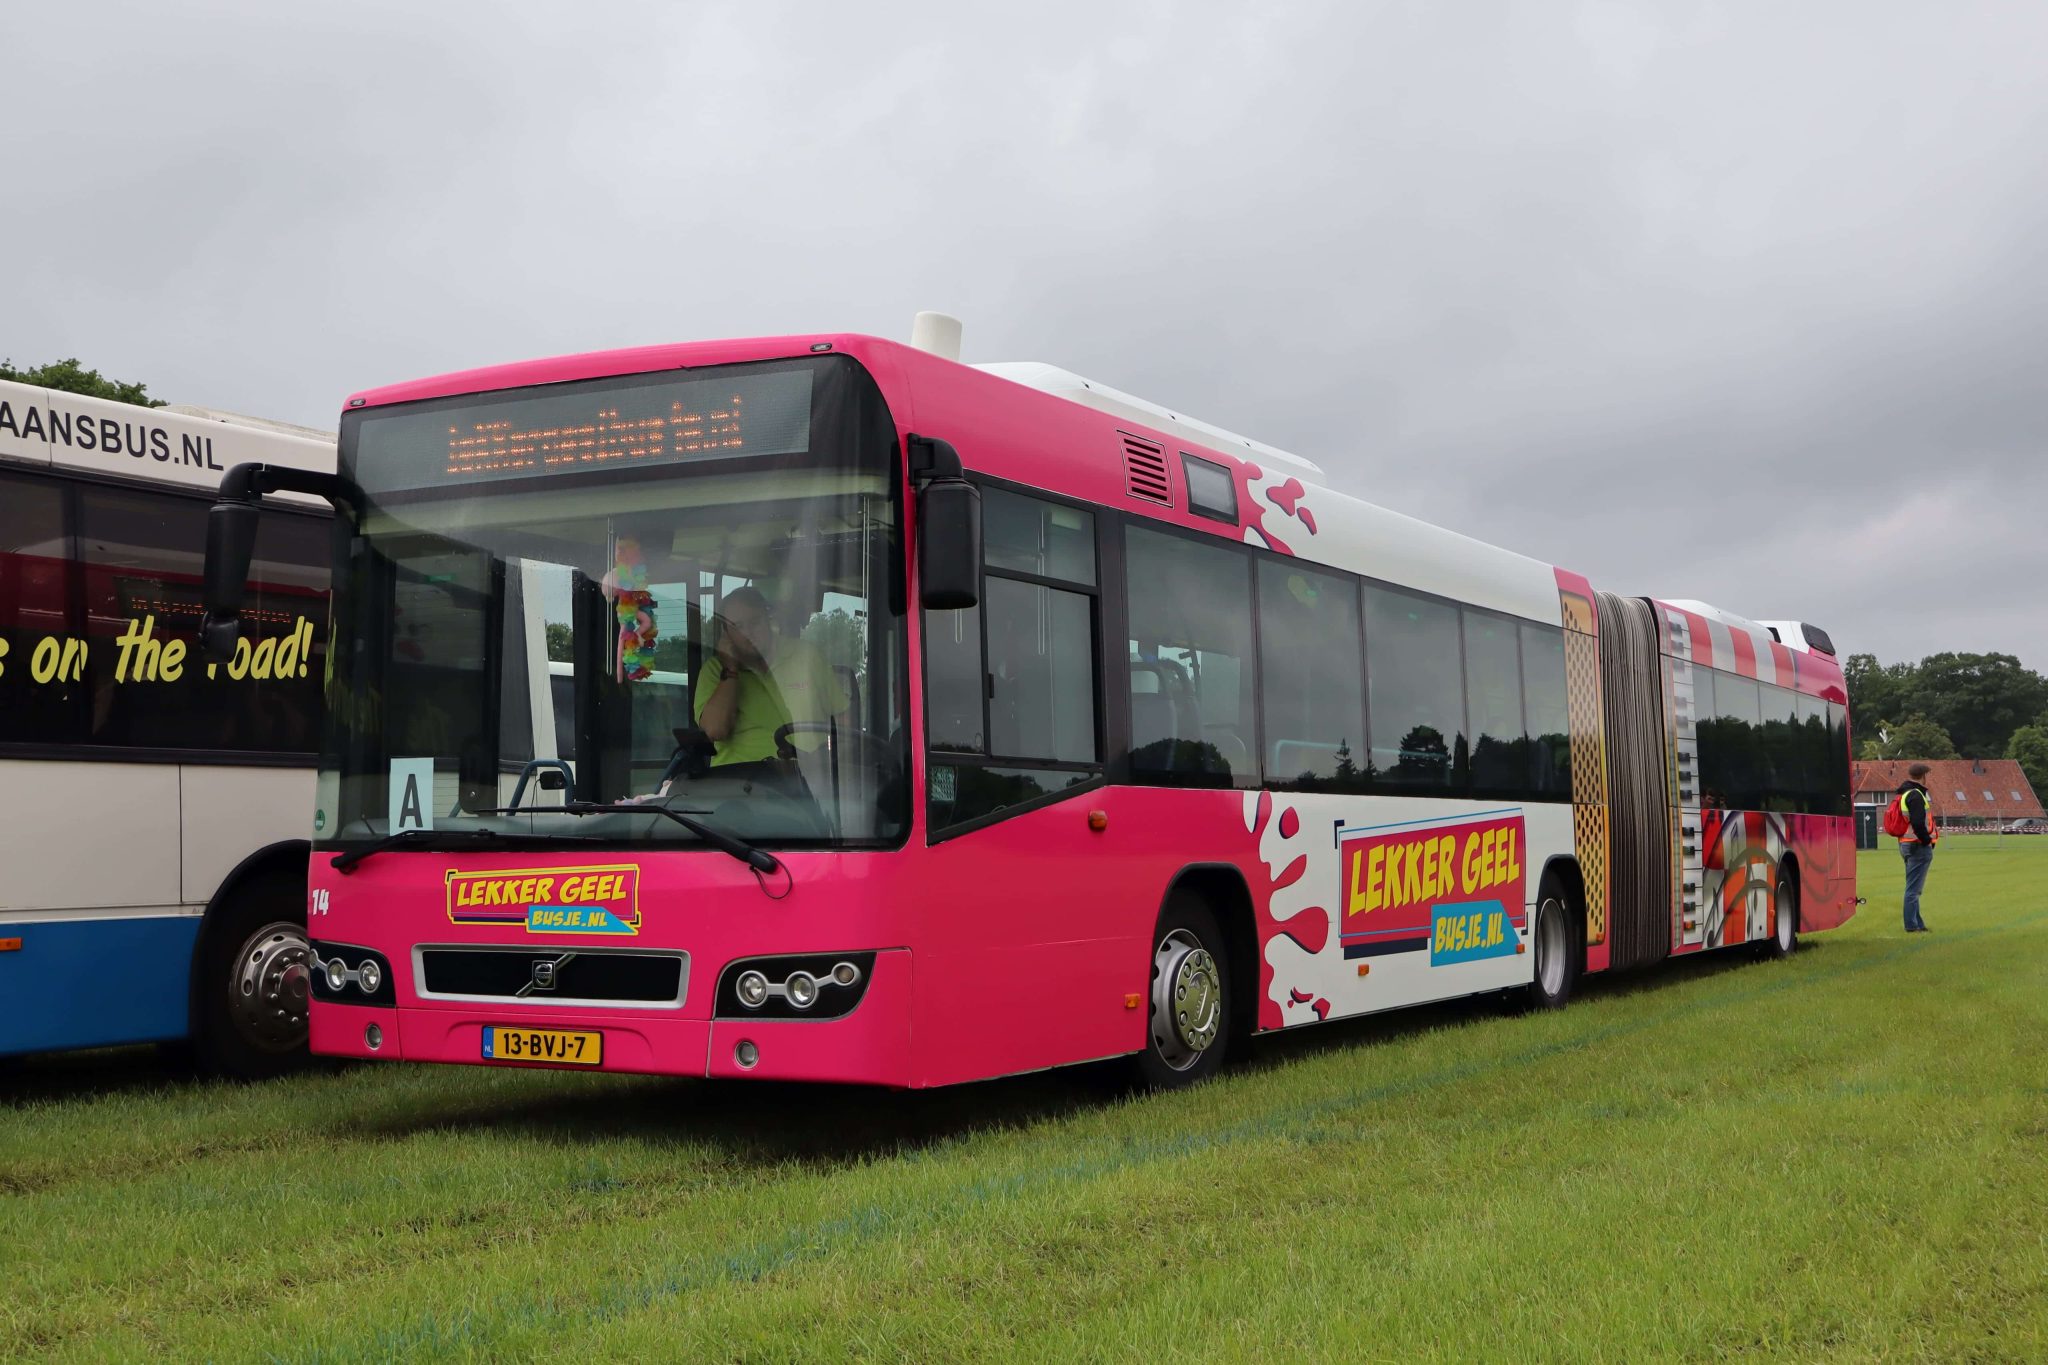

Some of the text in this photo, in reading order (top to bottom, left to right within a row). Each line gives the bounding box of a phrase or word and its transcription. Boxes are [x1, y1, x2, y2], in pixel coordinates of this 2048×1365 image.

[0, 401, 224, 471] AANSBUS.NL
[31, 636, 88, 684] on
[115, 615, 187, 684] the
[399, 773, 423, 828] A
[456, 874, 627, 907] LEKKER GEEL
[1349, 826, 1520, 918] LEKKER GEEL
[312, 889, 330, 916] 14
[531, 910, 608, 928] BUSJE.NL
[1434, 912, 1504, 954] BUSJE.NL
[503, 1032, 587, 1060] 13-BVJ-7
